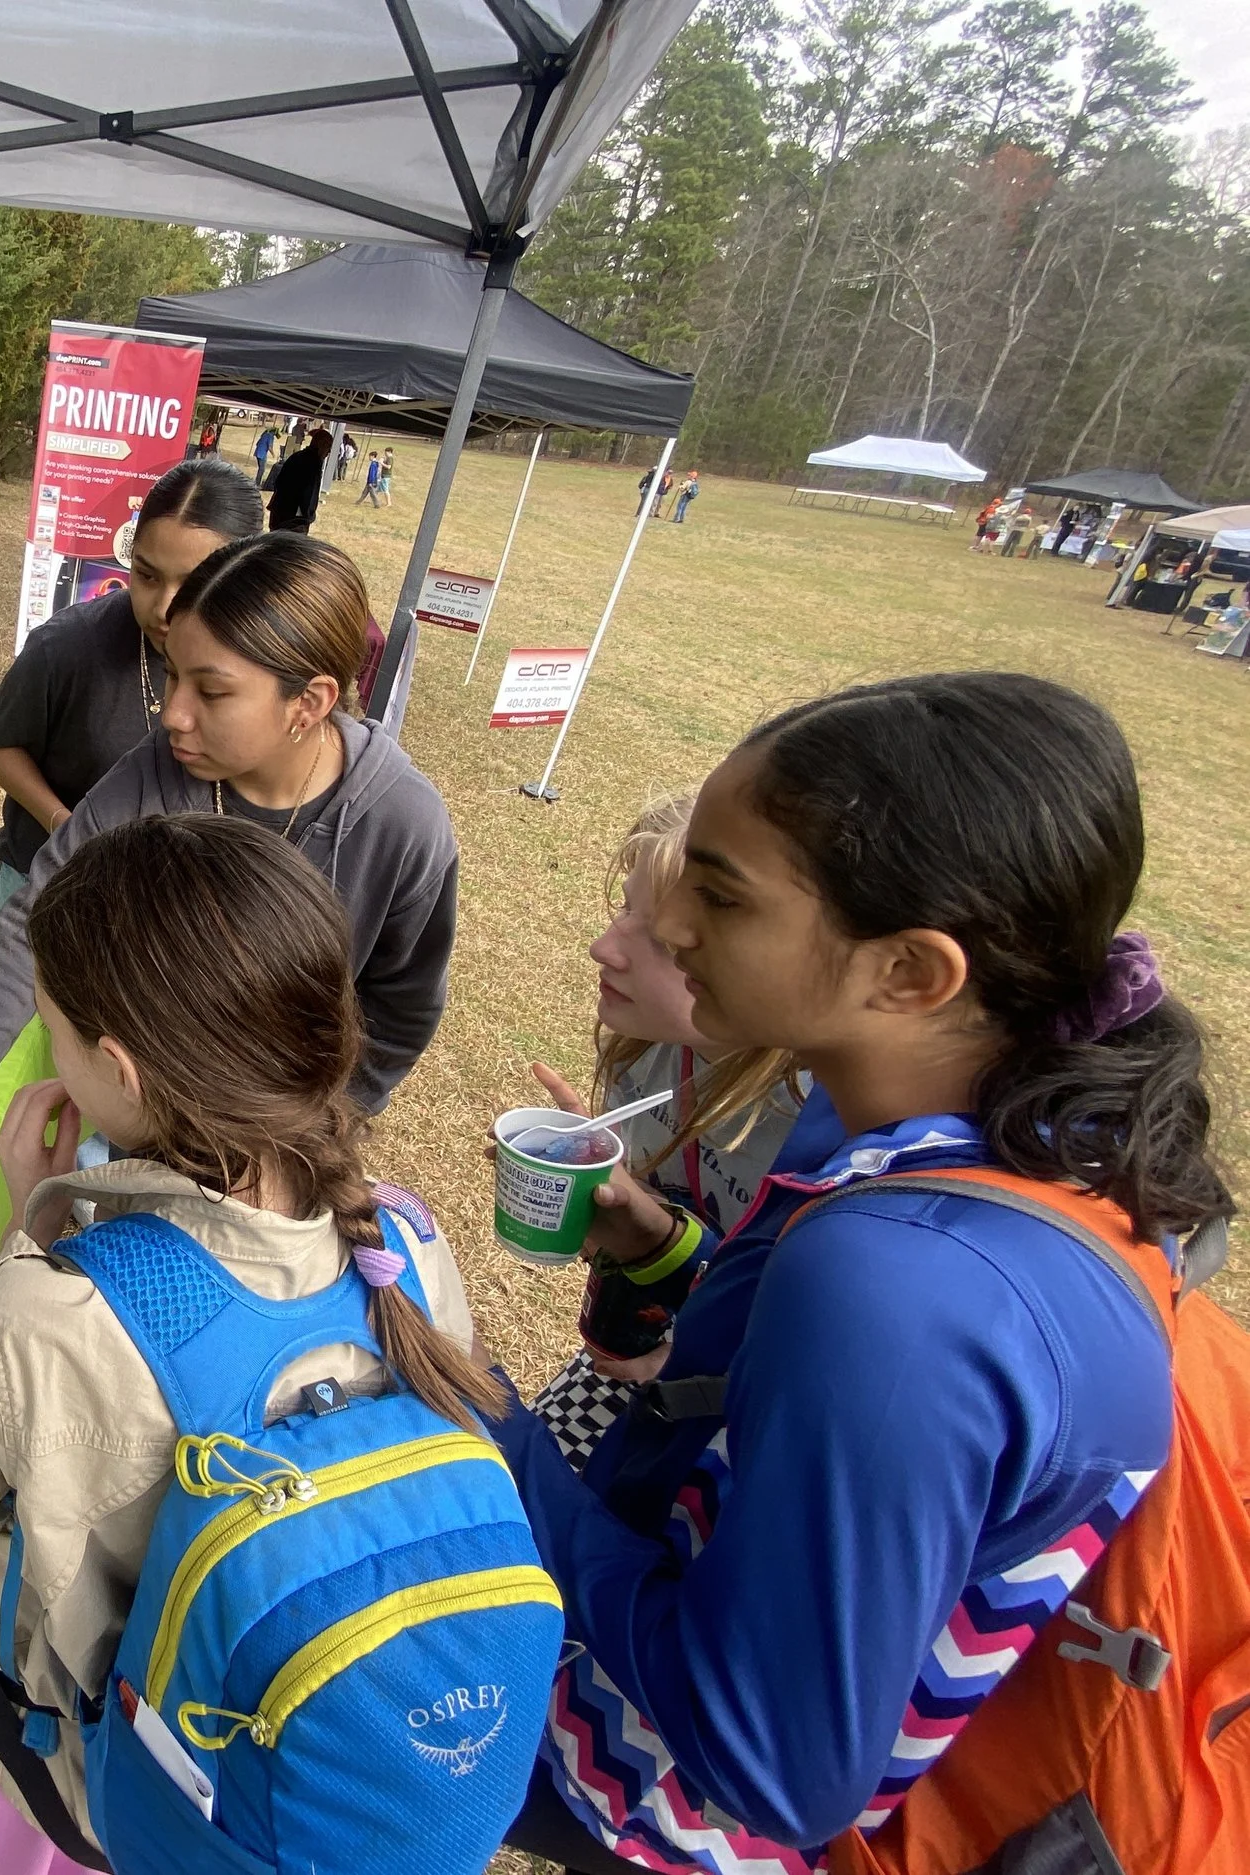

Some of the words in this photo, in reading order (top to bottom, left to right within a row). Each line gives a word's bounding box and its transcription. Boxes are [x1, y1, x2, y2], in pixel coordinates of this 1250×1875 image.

[48, 384, 182, 440] PRINTING
[49, 435, 120, 455] SIMPLIFIED
[67, 473, 91, 484] printing
[68, 464, 92, 473] seeking
[92, 467, 138, 479] comprehensive
[76, 532, 104, 541] Turnaround
[427, 602, 474, 618] 404.378.4231
[506, 697, 562, 708] 404.378.4231
[530, 1176, 554, 1191] CUP.
[522, 1195, 562, 1210] COMMUNITY
[408, 1684, 506, 1729] OSPREY
